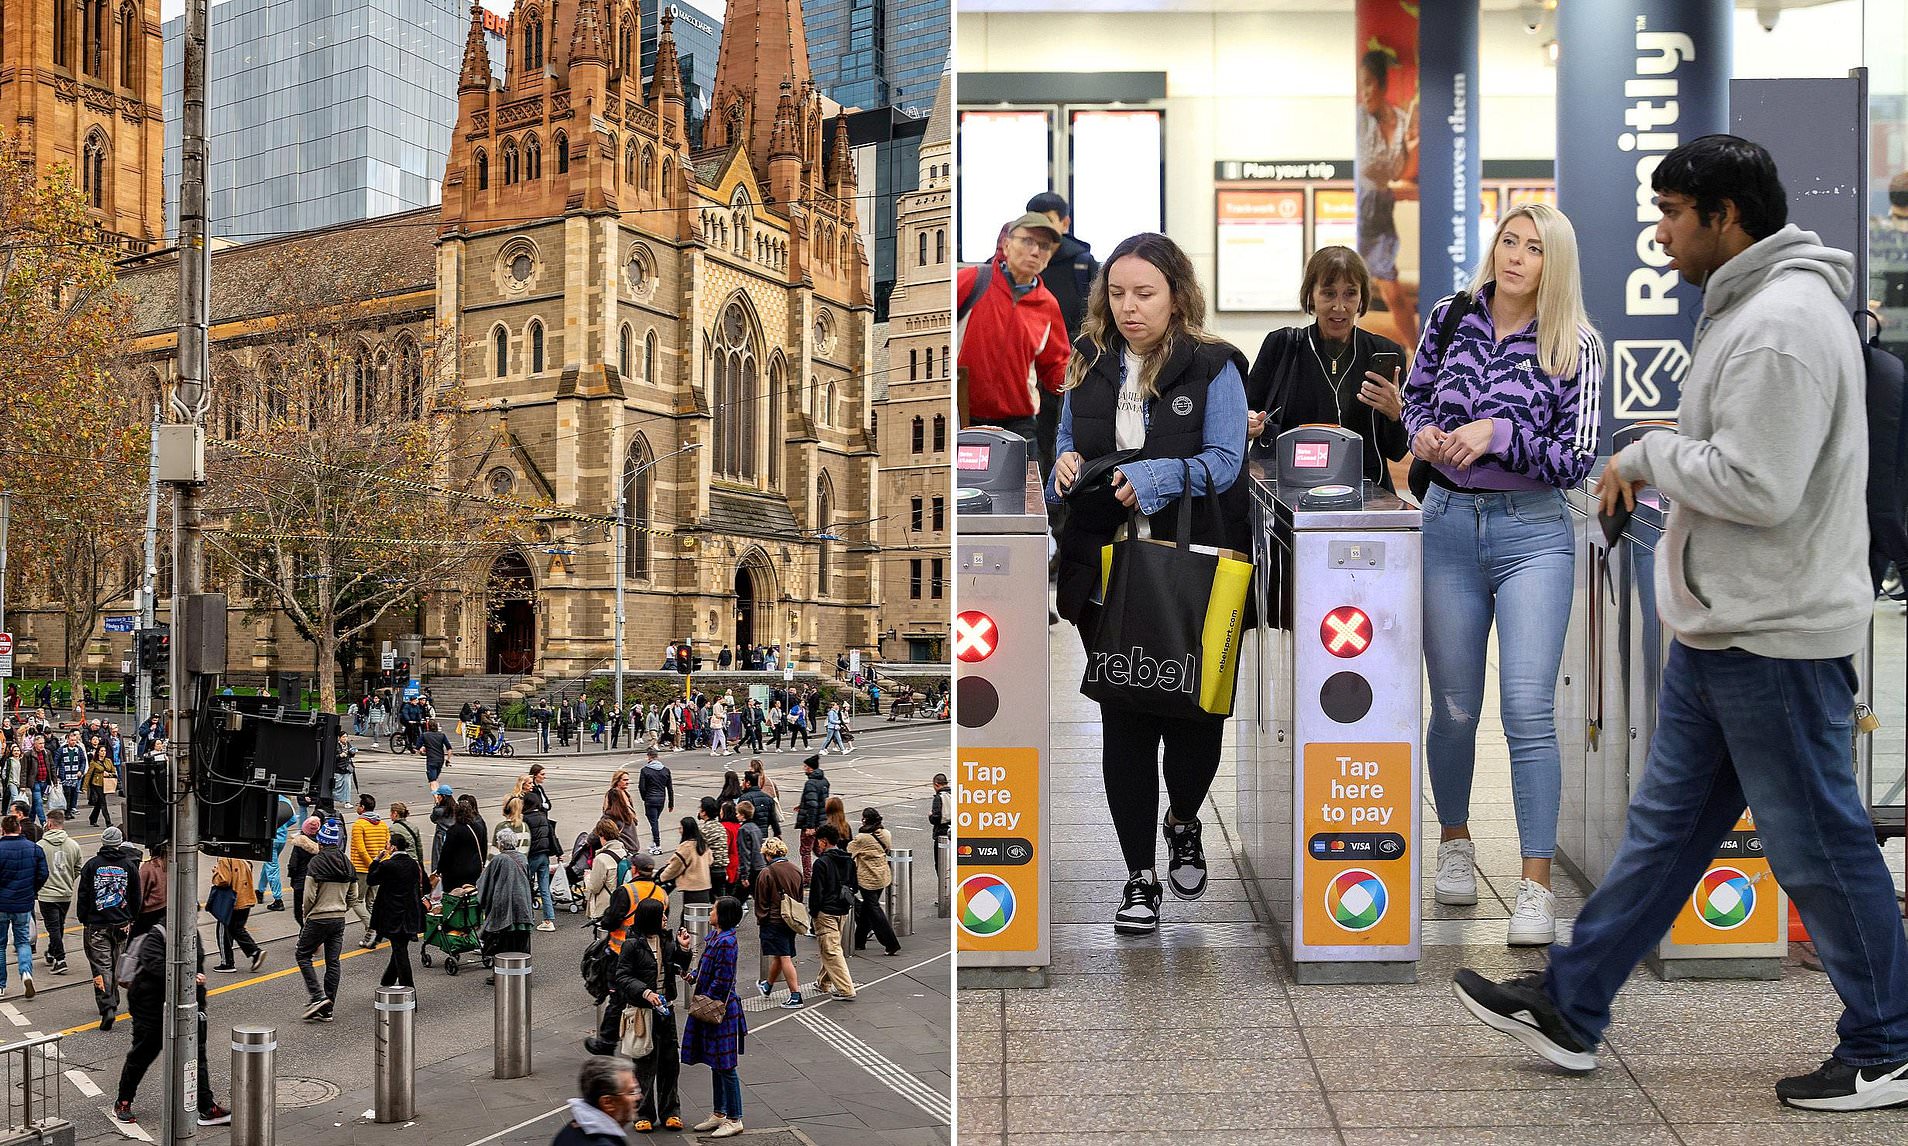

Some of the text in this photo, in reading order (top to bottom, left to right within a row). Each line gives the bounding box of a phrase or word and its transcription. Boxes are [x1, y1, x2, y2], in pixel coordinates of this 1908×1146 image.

[1447, 72, 1466, 134] them
[1243, 162, 1335, 180] Plan your trip
[1453, 137, 1466, 212] moves
[1447, 215, 1466, 263] that
[1218, 608, 1238, 674] rebelsport.com
[1087, 645, 1196, 694] rebel
[962, 761, 1007, 785] Tap
[1335, 756, 1379, 780] Tap
[958, 783, 1012, 804] here
[1331, 779, 1384, 799] here
[958, 811, 1021, 831] o pay
[1321, 803, 1394, 825] to pay
[977, 847, 998, 856] VISA
[1350, 842, 1371, 851] VISA
